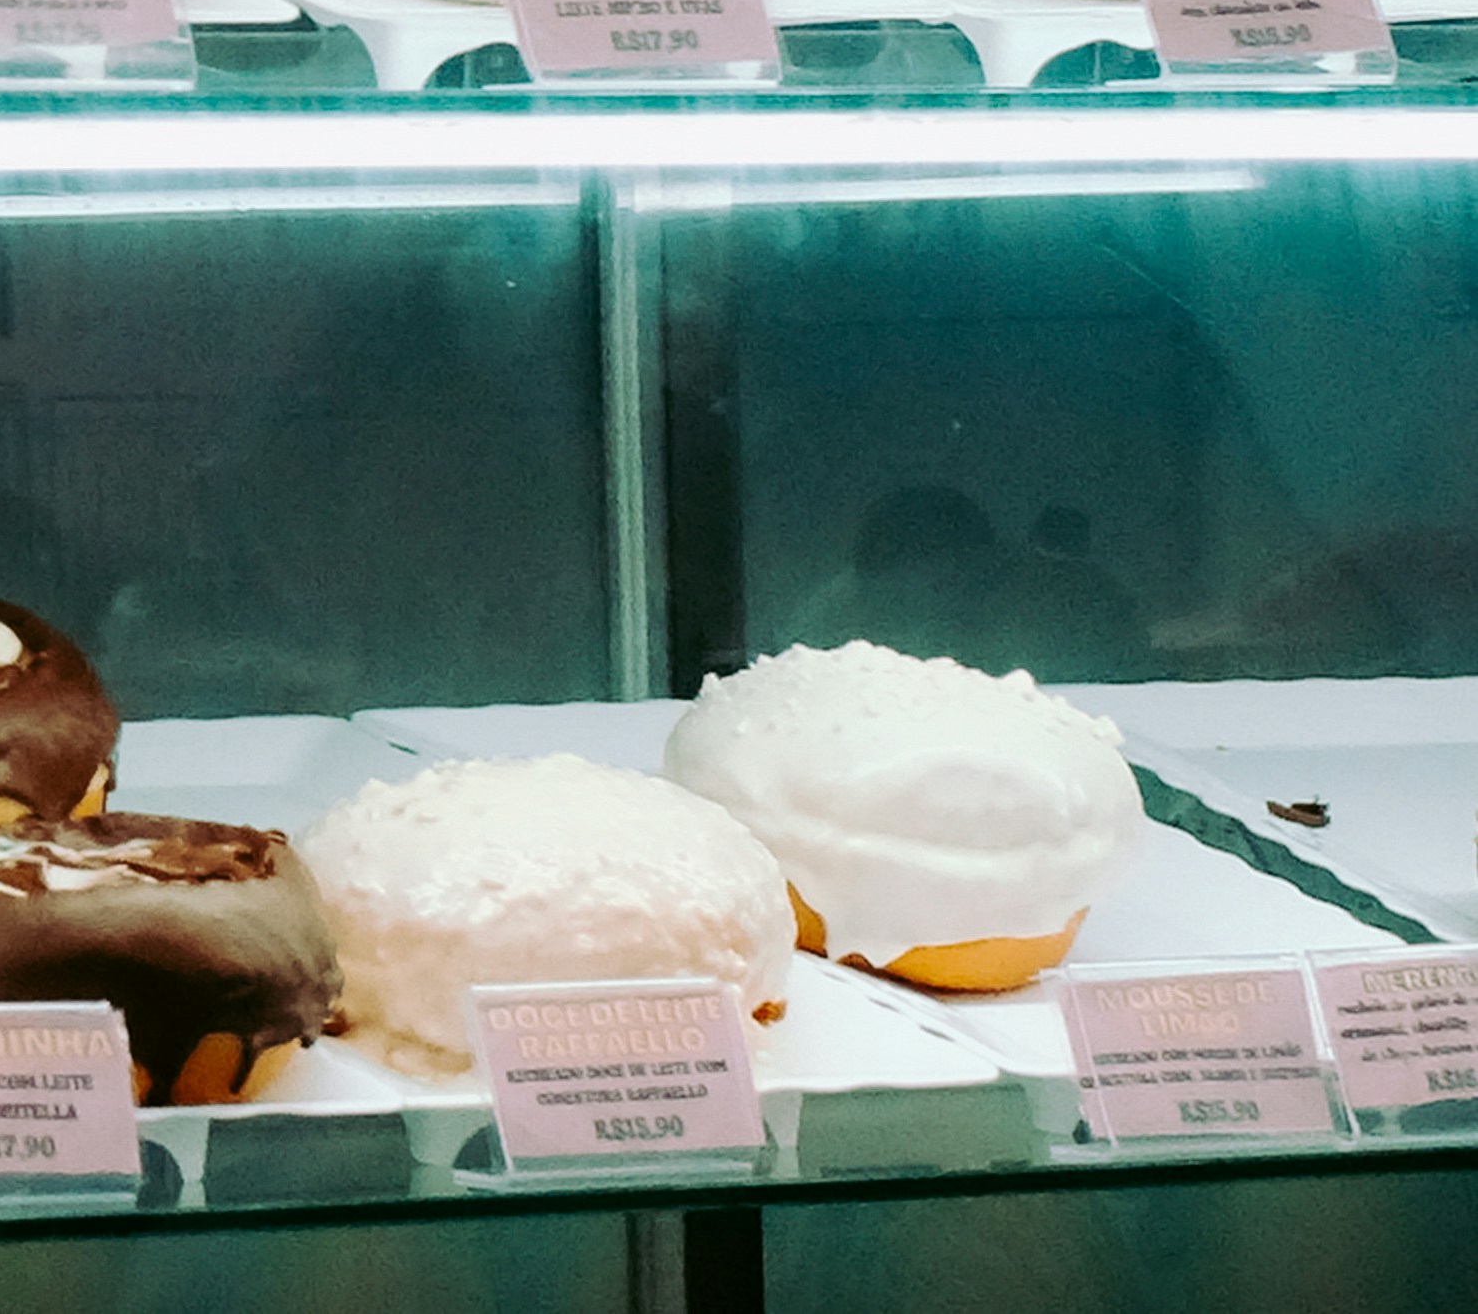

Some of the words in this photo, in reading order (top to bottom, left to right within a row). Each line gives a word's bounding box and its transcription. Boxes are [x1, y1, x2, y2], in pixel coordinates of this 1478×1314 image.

[487, 1003, 580, 1032] DOCE
[590, 999, 632, 1027] DE
[635, 994, 723, 1024] LEITE
[1093, 981, 1227, 1015] MOUSSE
[1233, 978, 1276, 1007] DE
[516, 1026, 707, 1061] RAFFAELLO
